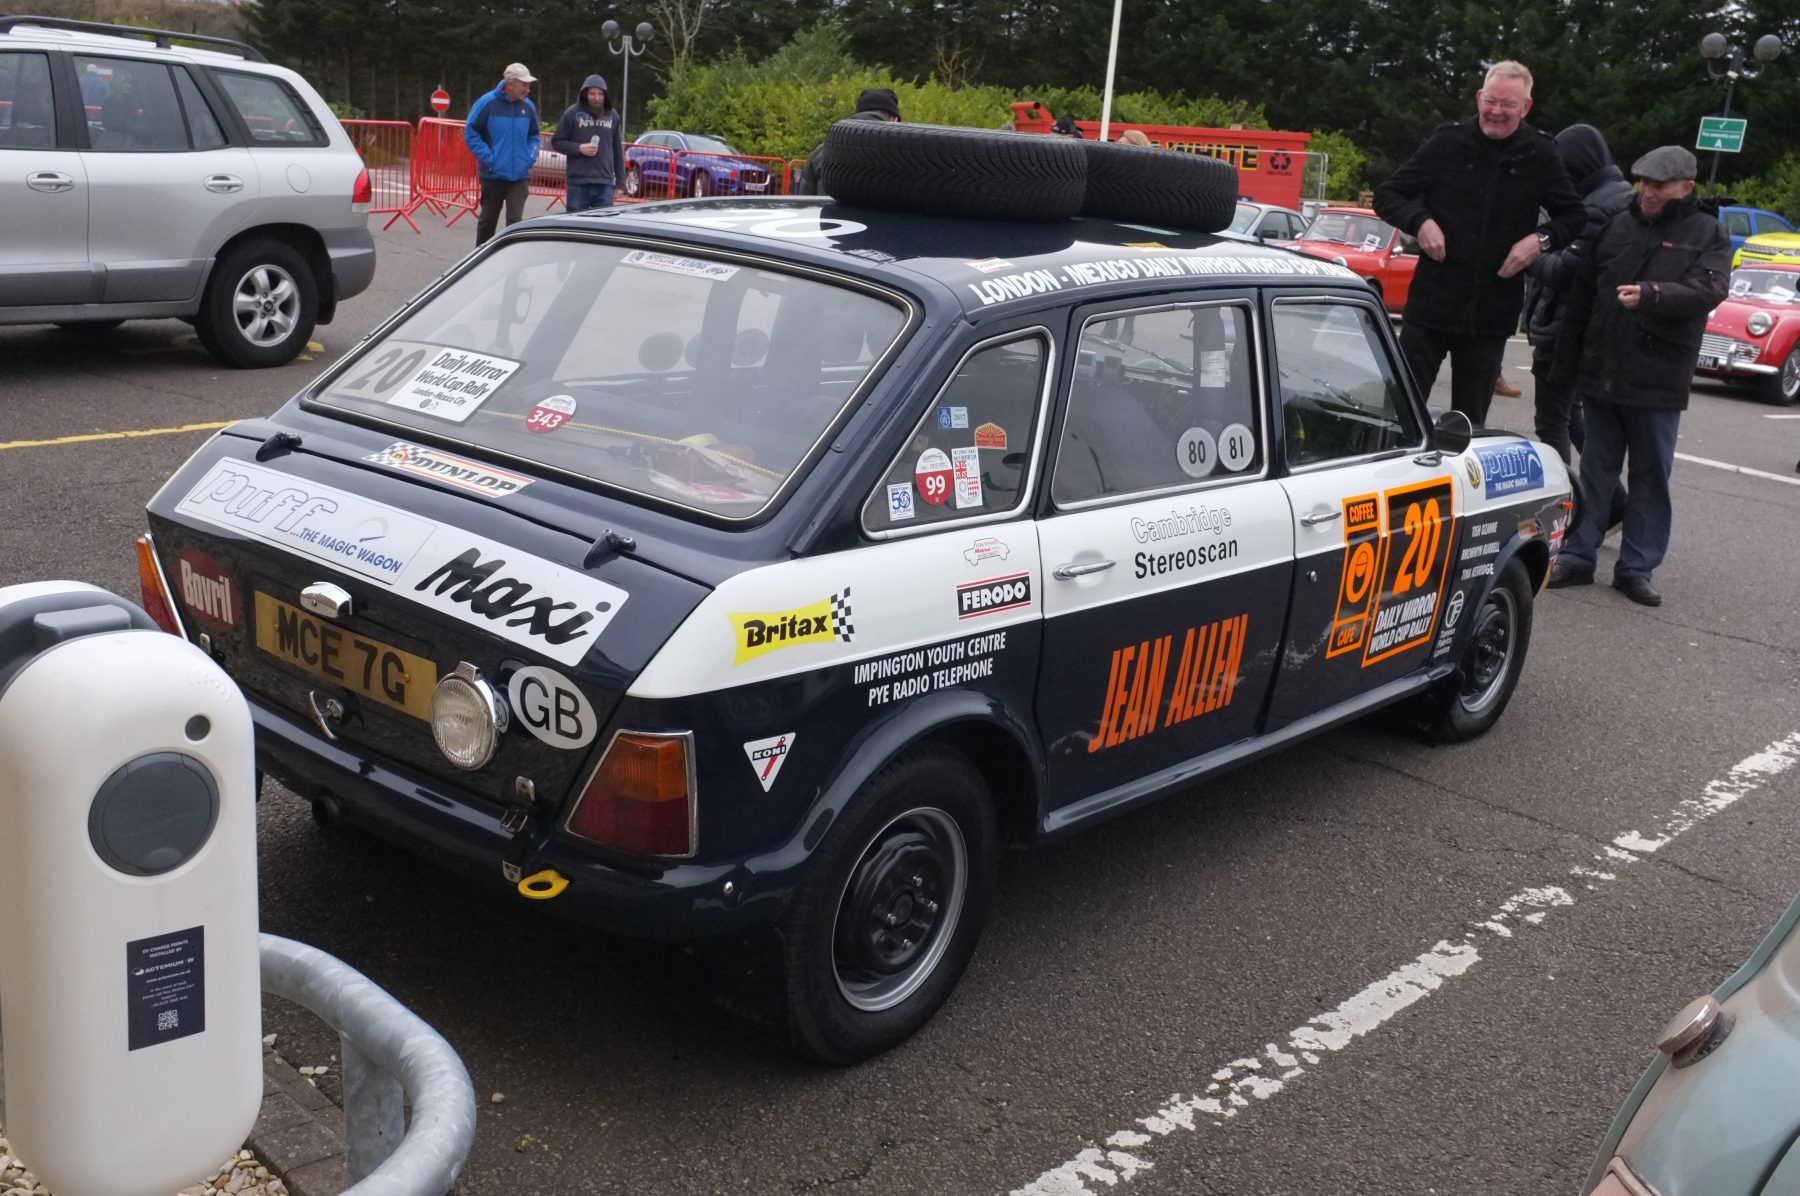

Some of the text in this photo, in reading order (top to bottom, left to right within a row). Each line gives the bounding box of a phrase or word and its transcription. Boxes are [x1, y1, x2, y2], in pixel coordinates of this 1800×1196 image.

[579, 117, 613, 128] Animal
[1714, 139, 1722, 148] A
[968, 268, 1062, 305] LONDON
[1061, 258, 1140, 287] MEXICO
[1132, 257, 1186, 278] DAILY
[1183, 256, 1248, 276] MIRROR
[1238, 256, 1294, 275] WORLD
[1288, 257, 1321, 276] CUP
[342, 348, 428, 394] 20
[414, 370, 491, 400] World Cup Rally
[431, 352, 510, 381] Daily Mirror
[527, 409, 563, 428] 343
[1188, 440, 1206, 464] 80
[1229, 435, 1244, 460] 81
[1480, 445, 1528, 481] puff
[410, 456, 518, 491] DUNLOP
[925, 475, 946, 496] 99
[189, 469, 338, 534] puff
[1349, 502, 1375, 523] COFFEE
[1130, 504, 1232, 544] Cambridge
[315, 534, 357, 556] MAGIC
[356, 547, 402, 574] WAGON
[1134, 538, 1238, 580] Stereoscan
[1391, 497, 1442, 596] 20
[180, 558, 234, 625] Bovril
[414, 547, 612, 645] Maxi
[962, 581, 1026, 611] FERODO
[744, 614, 828, 648] Britax
[1373, 591, 1437, 634] DAILY MIRROR
[278, 605, 406, 705] MCE 7G
[1368, 615, 1432, 655] WORLD CUP RALLY
[854, 632, 1007, 685] IMPINGTON YOUTH CENTRE
[868, 657, 994, 707] PYE RADIO TELEPHONE
[1087, 613, 1249, 754] JEAN ALLEN
[519, 675, 584, 741] GB
[753, 746, 786, 760] KONI
[145, 960, 184, 973] ACTEMIUM
